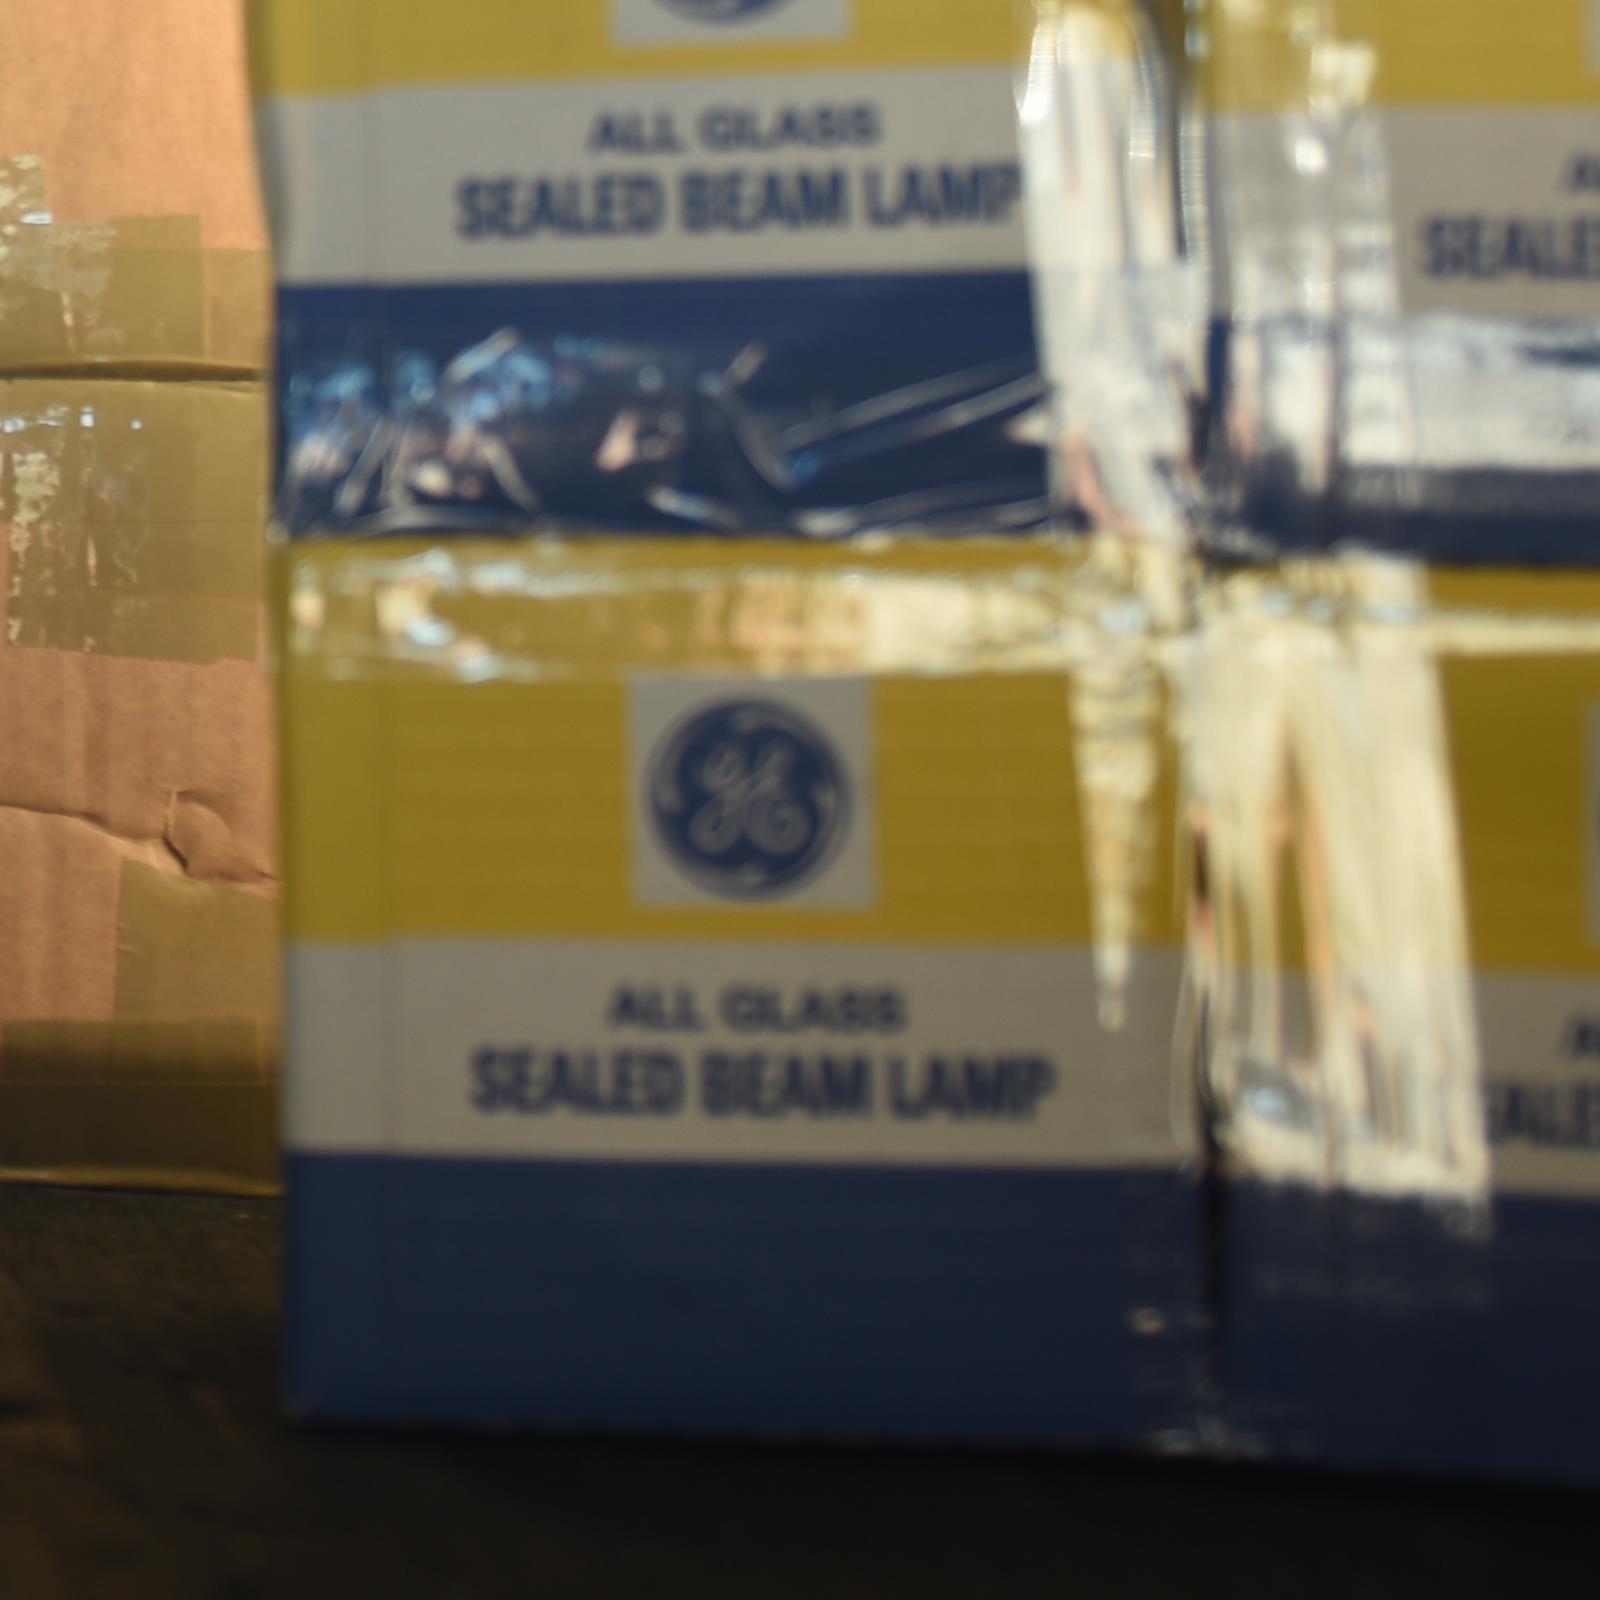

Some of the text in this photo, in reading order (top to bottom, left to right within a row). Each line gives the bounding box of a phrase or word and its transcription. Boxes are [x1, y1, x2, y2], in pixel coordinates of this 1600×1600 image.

[587, 102, 882, 156] ALL GLASS
[455, 159, 1022, 241] SEALED BEAM LAMP
[1420, 213, 1600, 283] SEALE
[606, 985, 909, 1036] ALL GLASS
[470, 1046, 1058, 1122] SEALED BEAM LAMP
